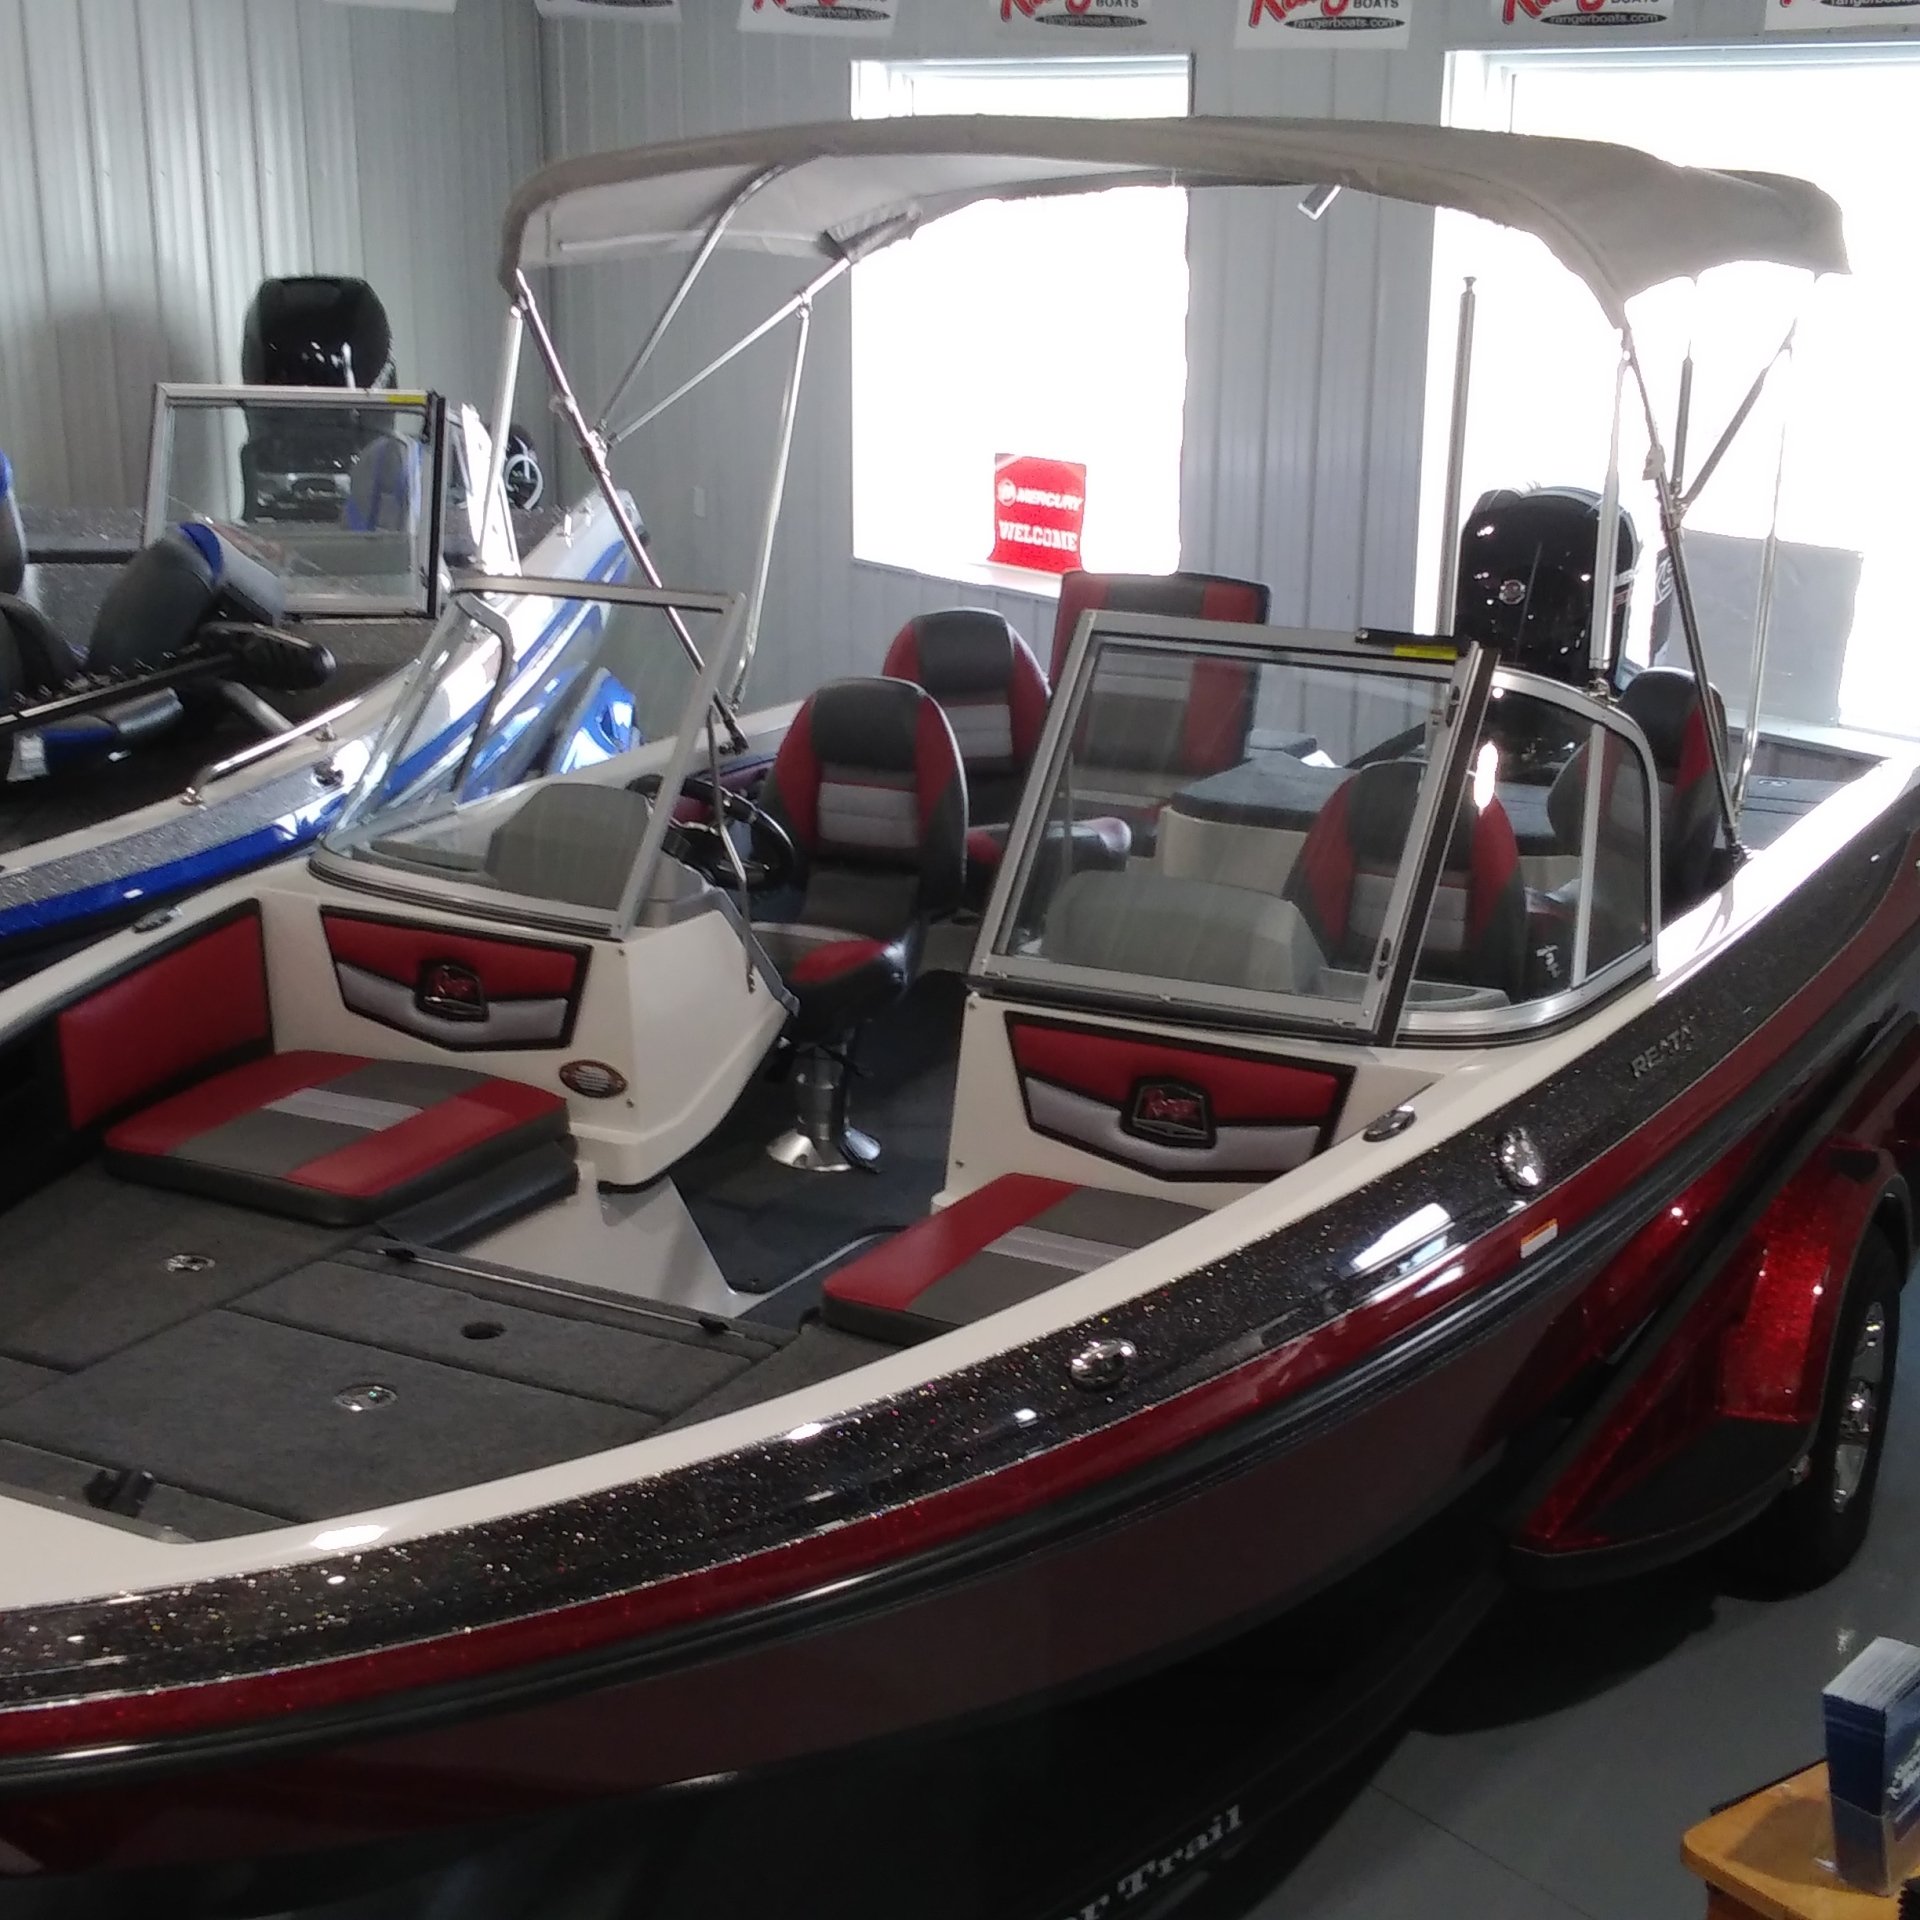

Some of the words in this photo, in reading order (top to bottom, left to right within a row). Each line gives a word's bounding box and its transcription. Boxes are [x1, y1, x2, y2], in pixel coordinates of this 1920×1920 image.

[1294, 17, 1397, 30] rangerboats.com
[1551, 13, 1659, 25] rangerboats.com
[1016, 487, 1084, 512] MERCURY
[998, 520, 1079, 552] WELCOME
[1116, 1804, 1243, 1901] Trail
